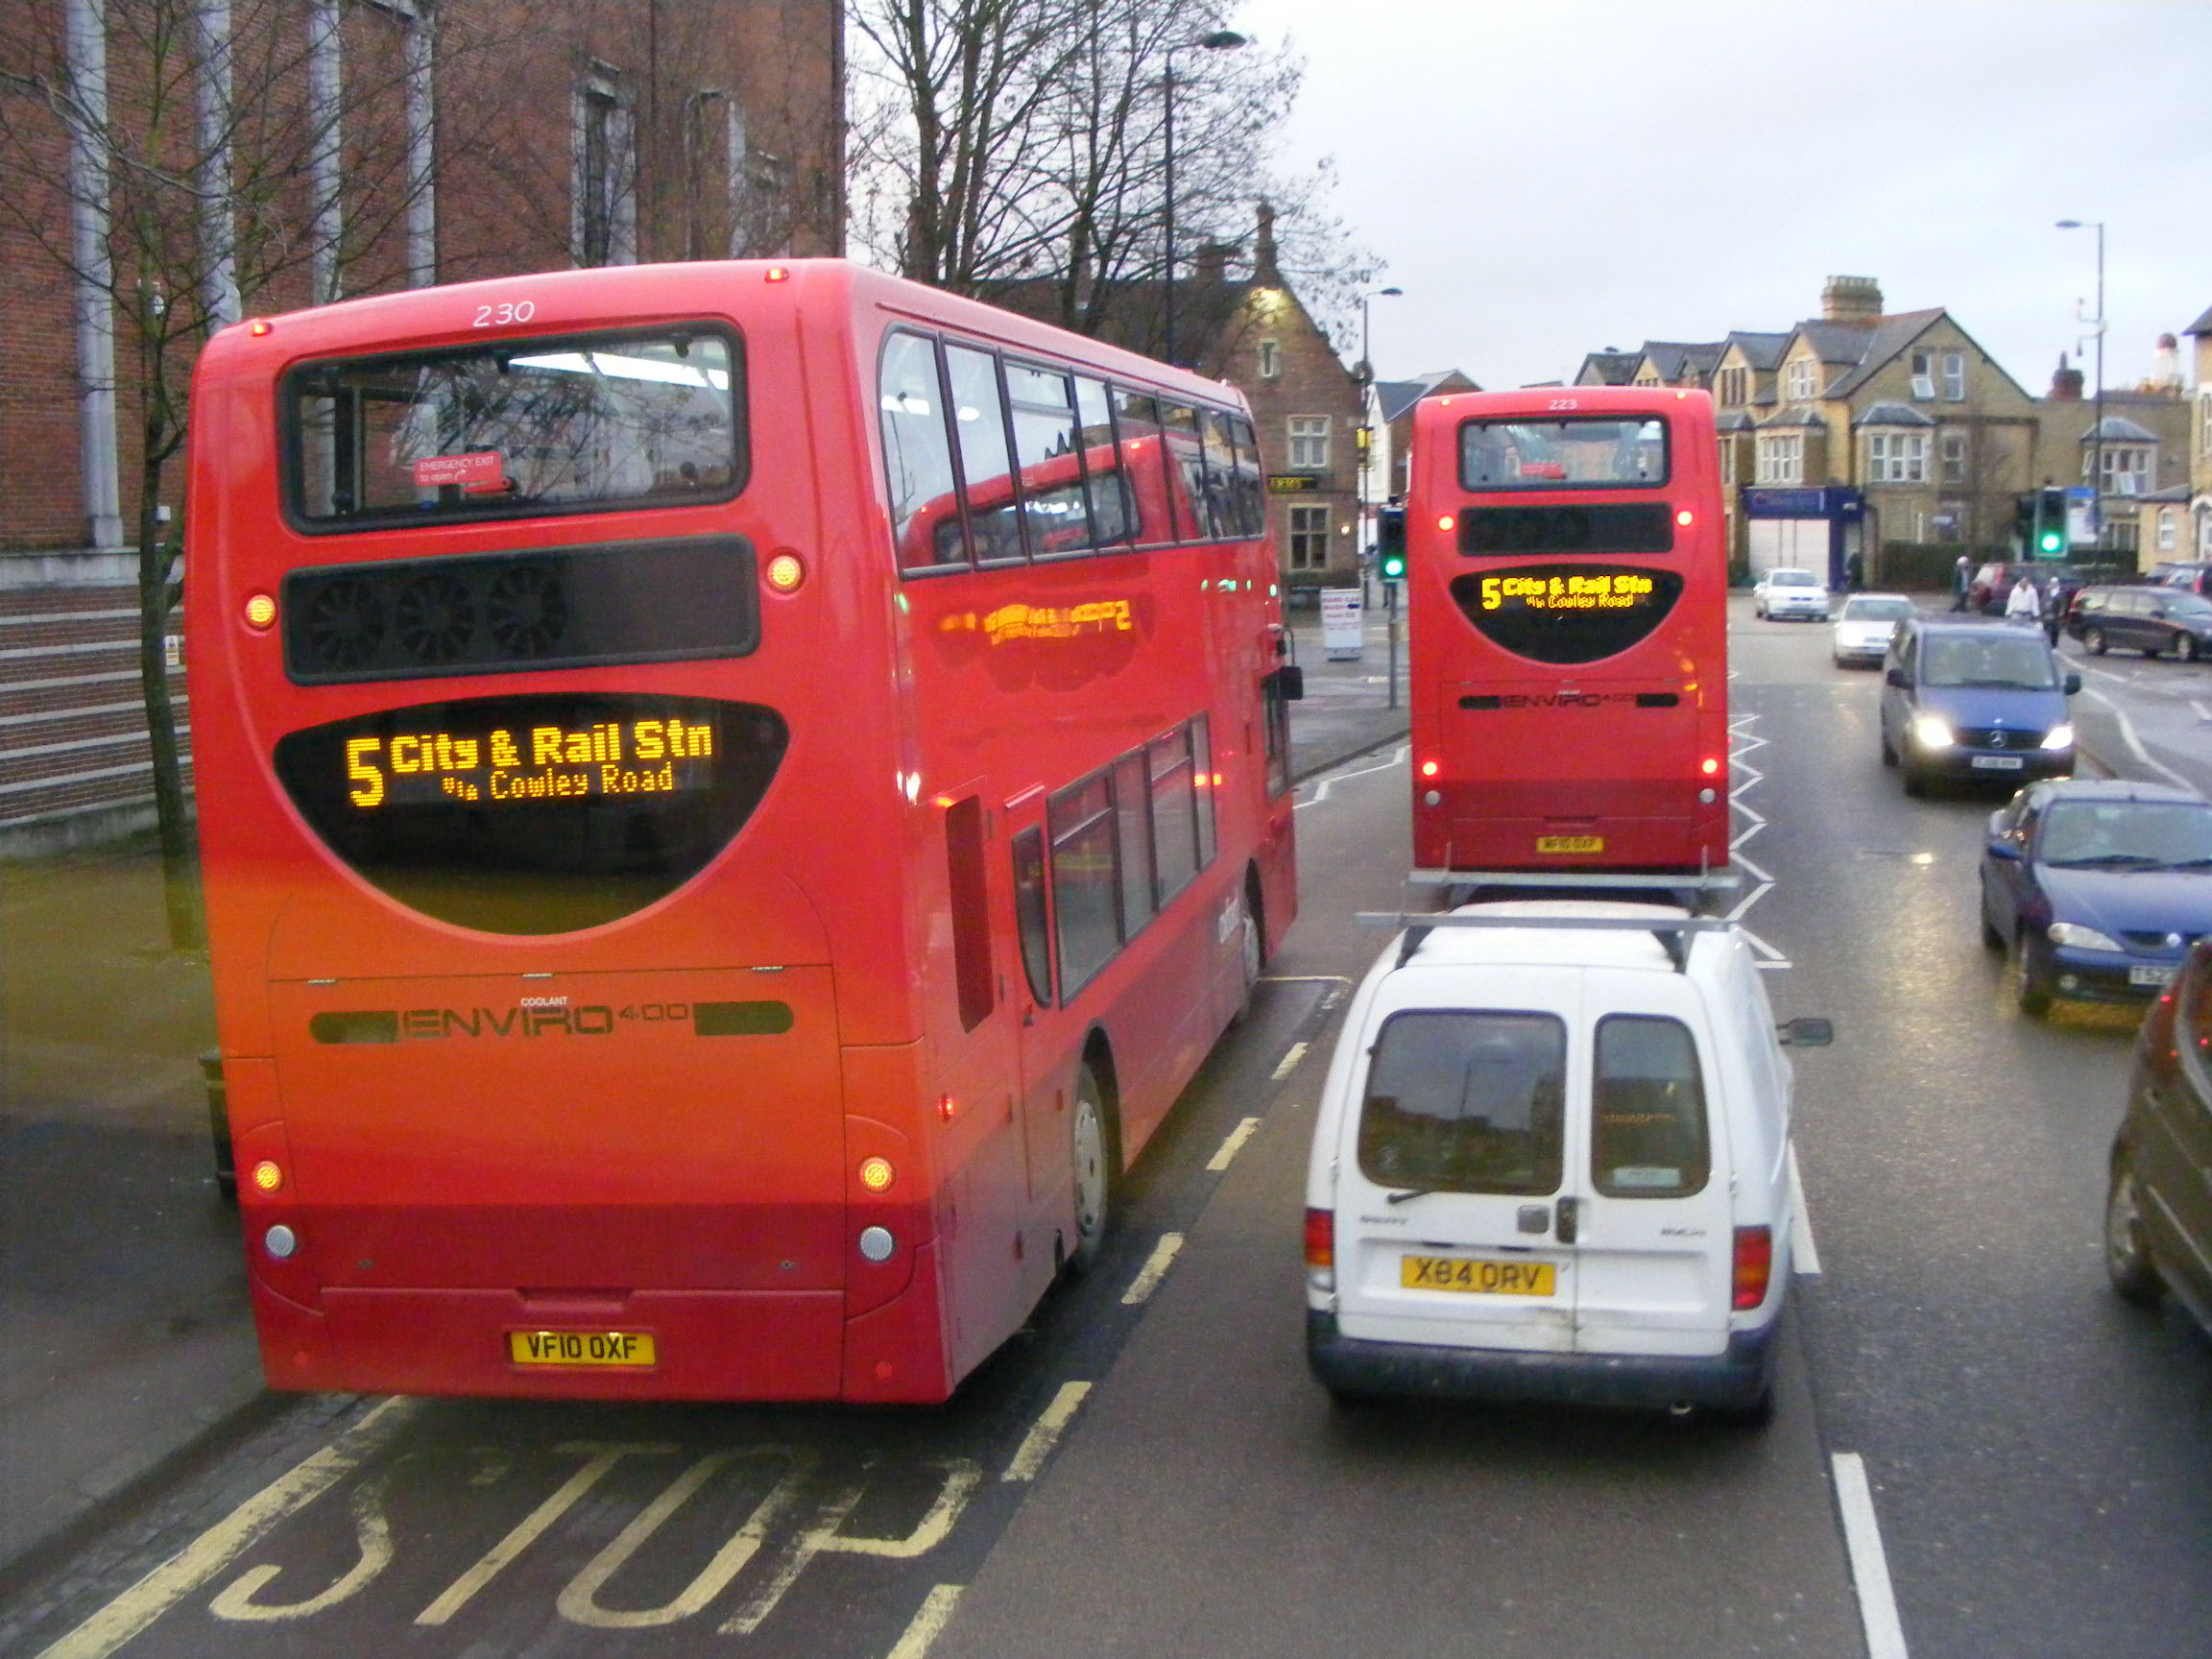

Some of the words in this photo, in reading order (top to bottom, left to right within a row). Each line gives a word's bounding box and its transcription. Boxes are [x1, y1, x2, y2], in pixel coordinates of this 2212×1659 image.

[472, 301, 536, 327] 230
[1548, 398, 1578, 411] 223
[420, 458, 473, 471] EMERGENCY
[475, 455, 494, 467] EXIT
[1481, 578, 1502, 610] 5
[1502, 577, 1546, 595] City
[1549, 576, 1566, 594] &
[1569, 576, 1611, 594] Rail
[1613, 576, 1652, 594] Stn
[1548, 593, 1597, 609] Cowley
[1599, 592, 1634, 608] Road
[346, 737, 385, 807] 5
[390, 733, 479, 773] City
[490, 729, 521, 767] &
[532, 723, 621, 765] Rail
[634, 719, 712, 759] Stn
[490, 767, 589, 800] Cowley
[601, 760, 674, 794] Road
[520, 996, 569, 1007] COOLANT
[402, 1005, 614, 1038] ENVIRO
[618, 1003, 688, 1021] 400
[1481, 1262, 1542, 1289] ORV
[527, 1335, 582, 1358] VF10
[589, 1335, 638, 1359] OXF
[207, 1442, 982, 1636] STOP
